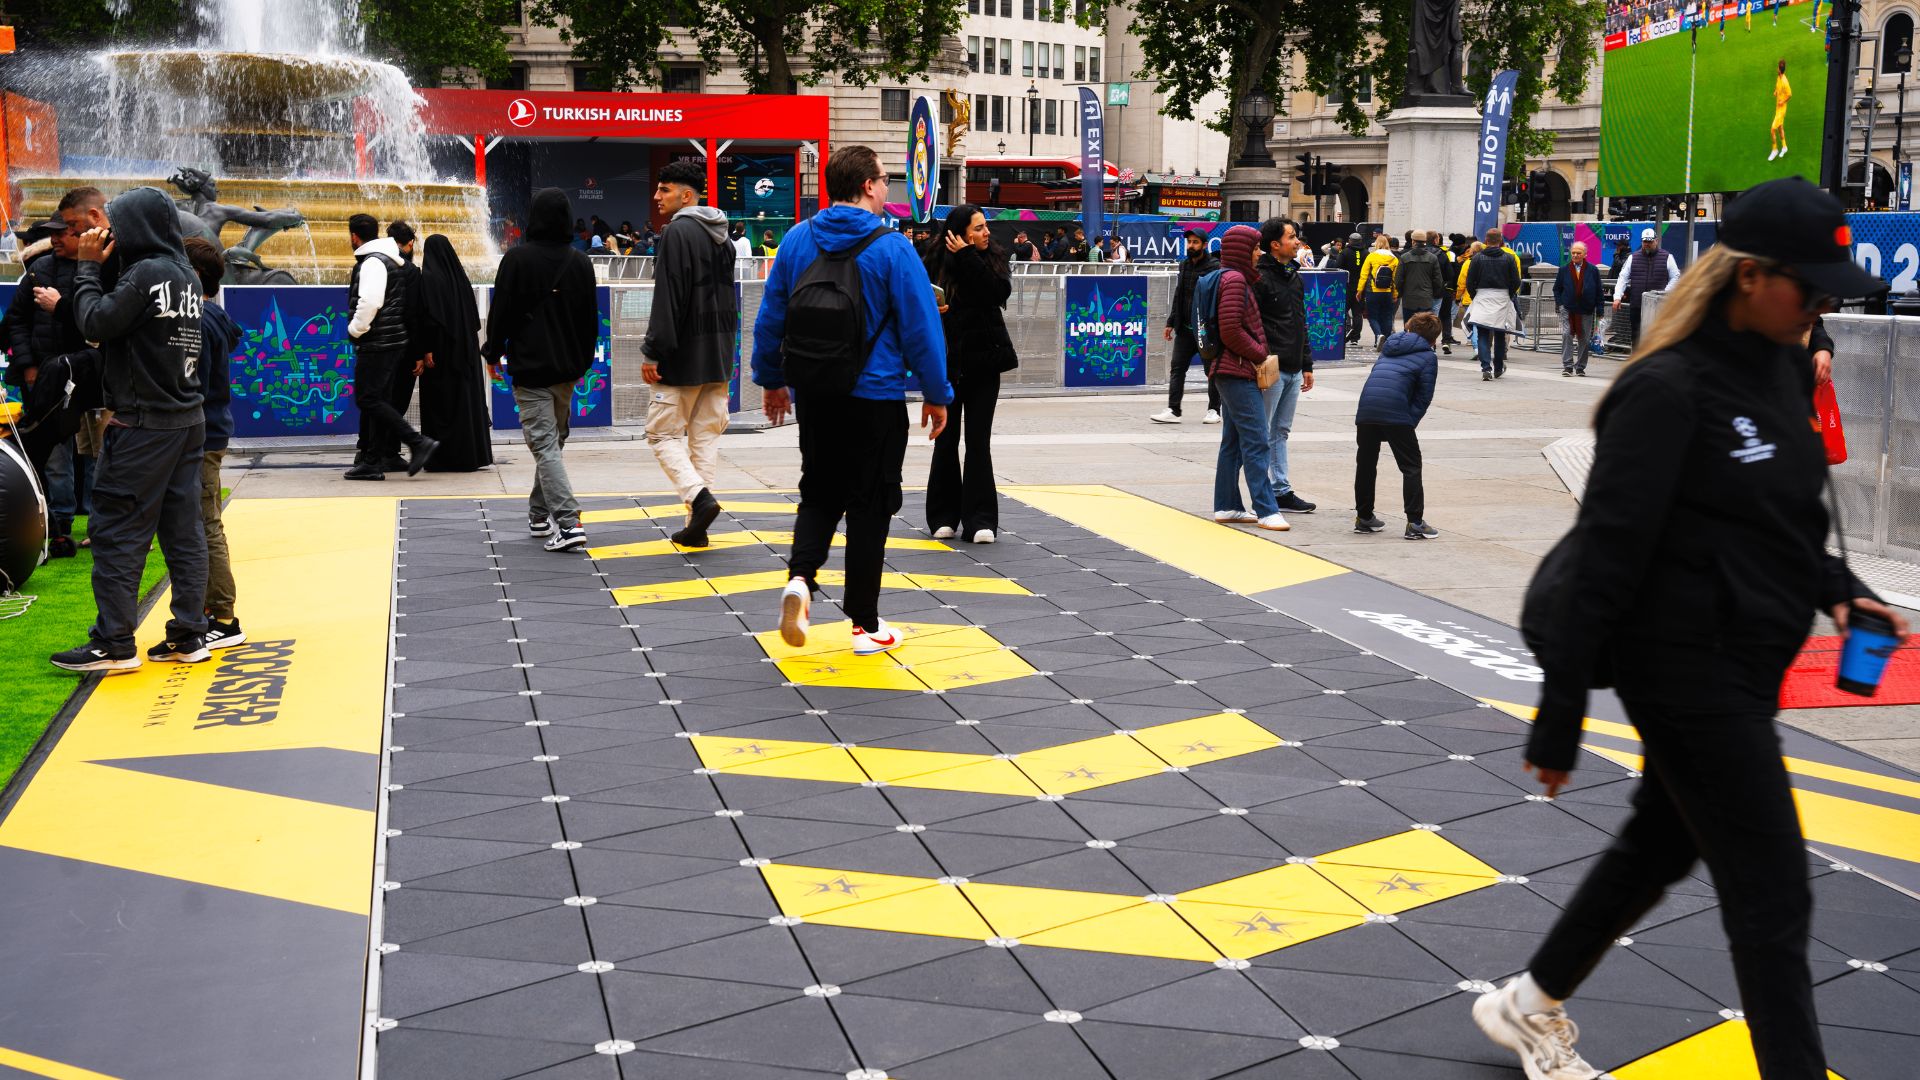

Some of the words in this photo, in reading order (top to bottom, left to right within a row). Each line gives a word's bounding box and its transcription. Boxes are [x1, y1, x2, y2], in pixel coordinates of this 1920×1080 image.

[543, 107, 611, 121] TURKISH
[615, 108, 683, 122] AIRLINES
[1087, 127, 1101, 172] EXIT
[1177, 199, 1206, 207] TICKETS
[1207, 200, 1223, 208] HER
[1124, 321, 1143, 336] 24
[162, 662, 193, 689] ERGY
[193, 638, 296, 730] ROCKSTAR
[143, 693, 180, 729] DRINK
